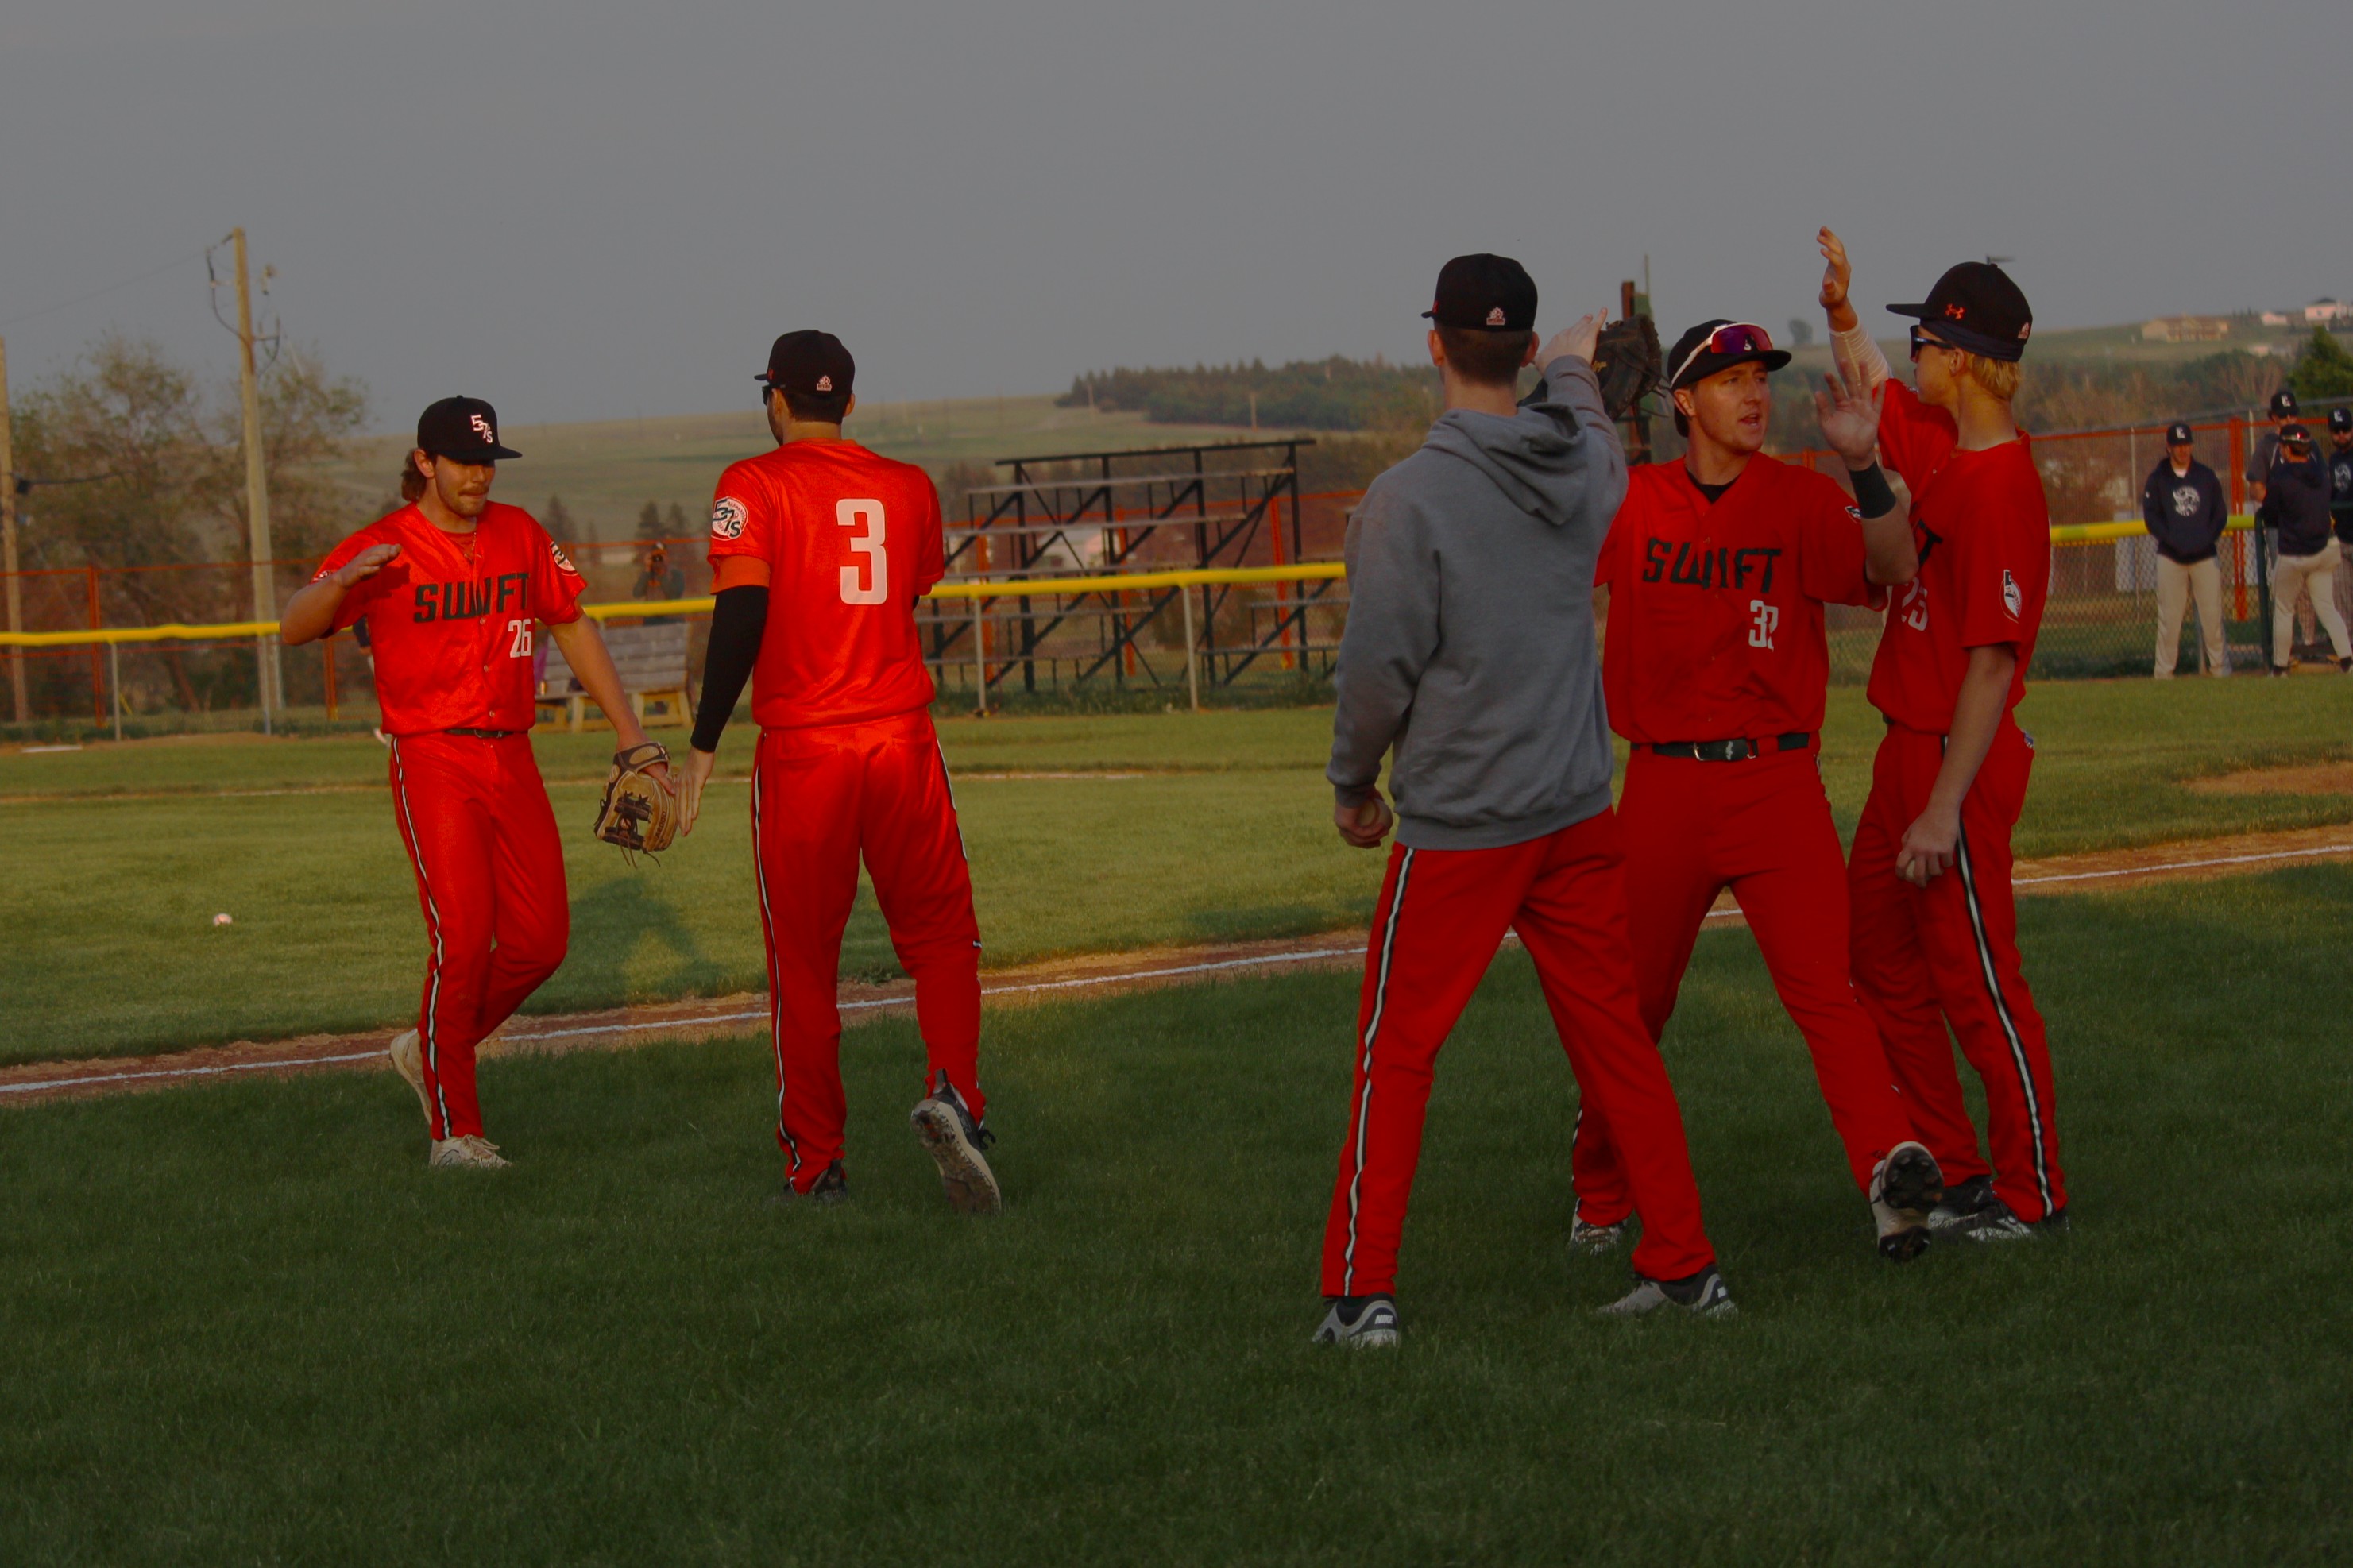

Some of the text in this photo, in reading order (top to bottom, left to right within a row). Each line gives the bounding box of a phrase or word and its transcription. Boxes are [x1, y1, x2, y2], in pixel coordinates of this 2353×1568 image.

[836, 498, 887, 605] 3
[1643, 537, 1782, 593] SWIFT
[414, 572, 530, 623] SWIFT
[508, 618, 532, 658] 26
[1374, 1314, 1394, 1325] NIKE
